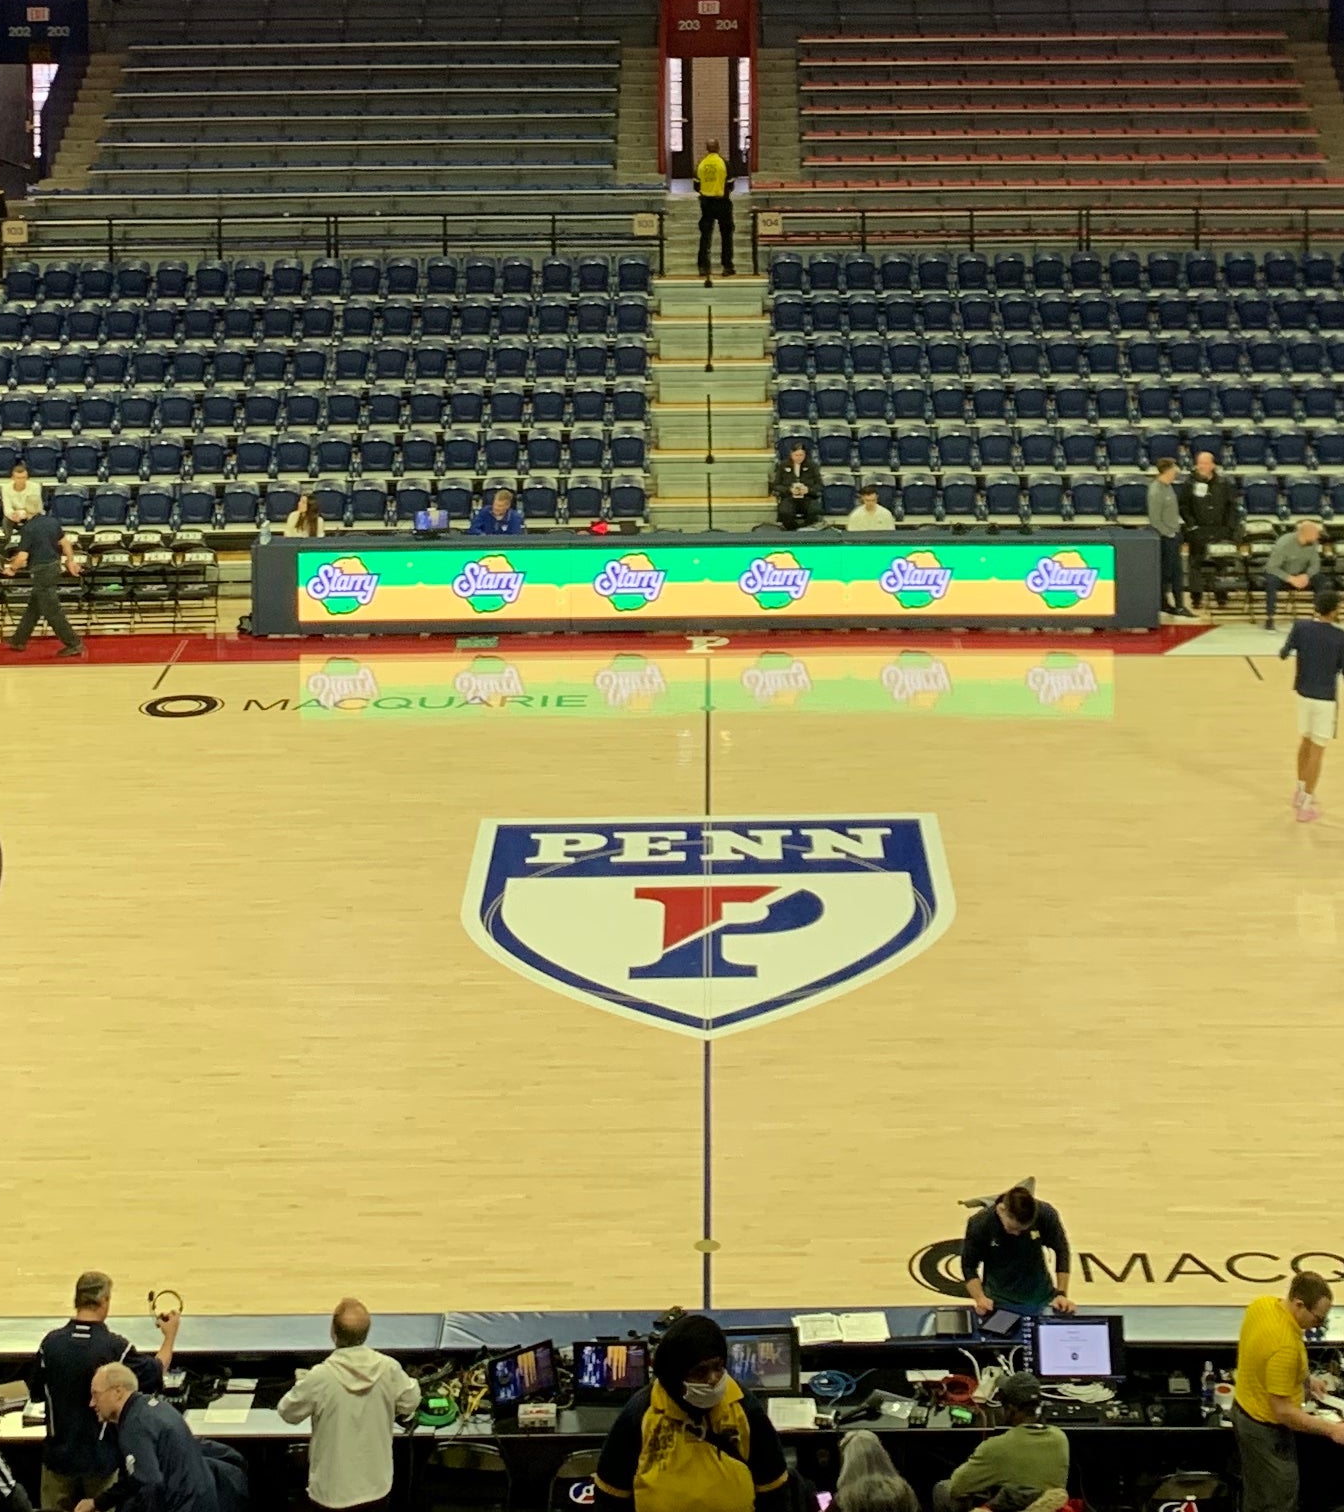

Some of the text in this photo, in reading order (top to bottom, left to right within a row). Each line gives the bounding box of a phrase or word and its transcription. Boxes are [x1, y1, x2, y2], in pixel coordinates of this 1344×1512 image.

[8, 26, 32, 37] 202
[678, 19, 738, 31] 203 204
[307, 563, 381, 605] Starry
[452, 561, 526, 603] Starry
[593, 559, 668, 601] Starry
[738, 558, 813, 600] Starry
[879, 557, 954, 599] Starry
[1025, 557, 1099, 599] Starry
[686, 636, 729, 653] P
[243, 694, 589, 712] MACQUARIE
[525, 827, 892, 864] PENN
[628, 885, 825, 979] P
